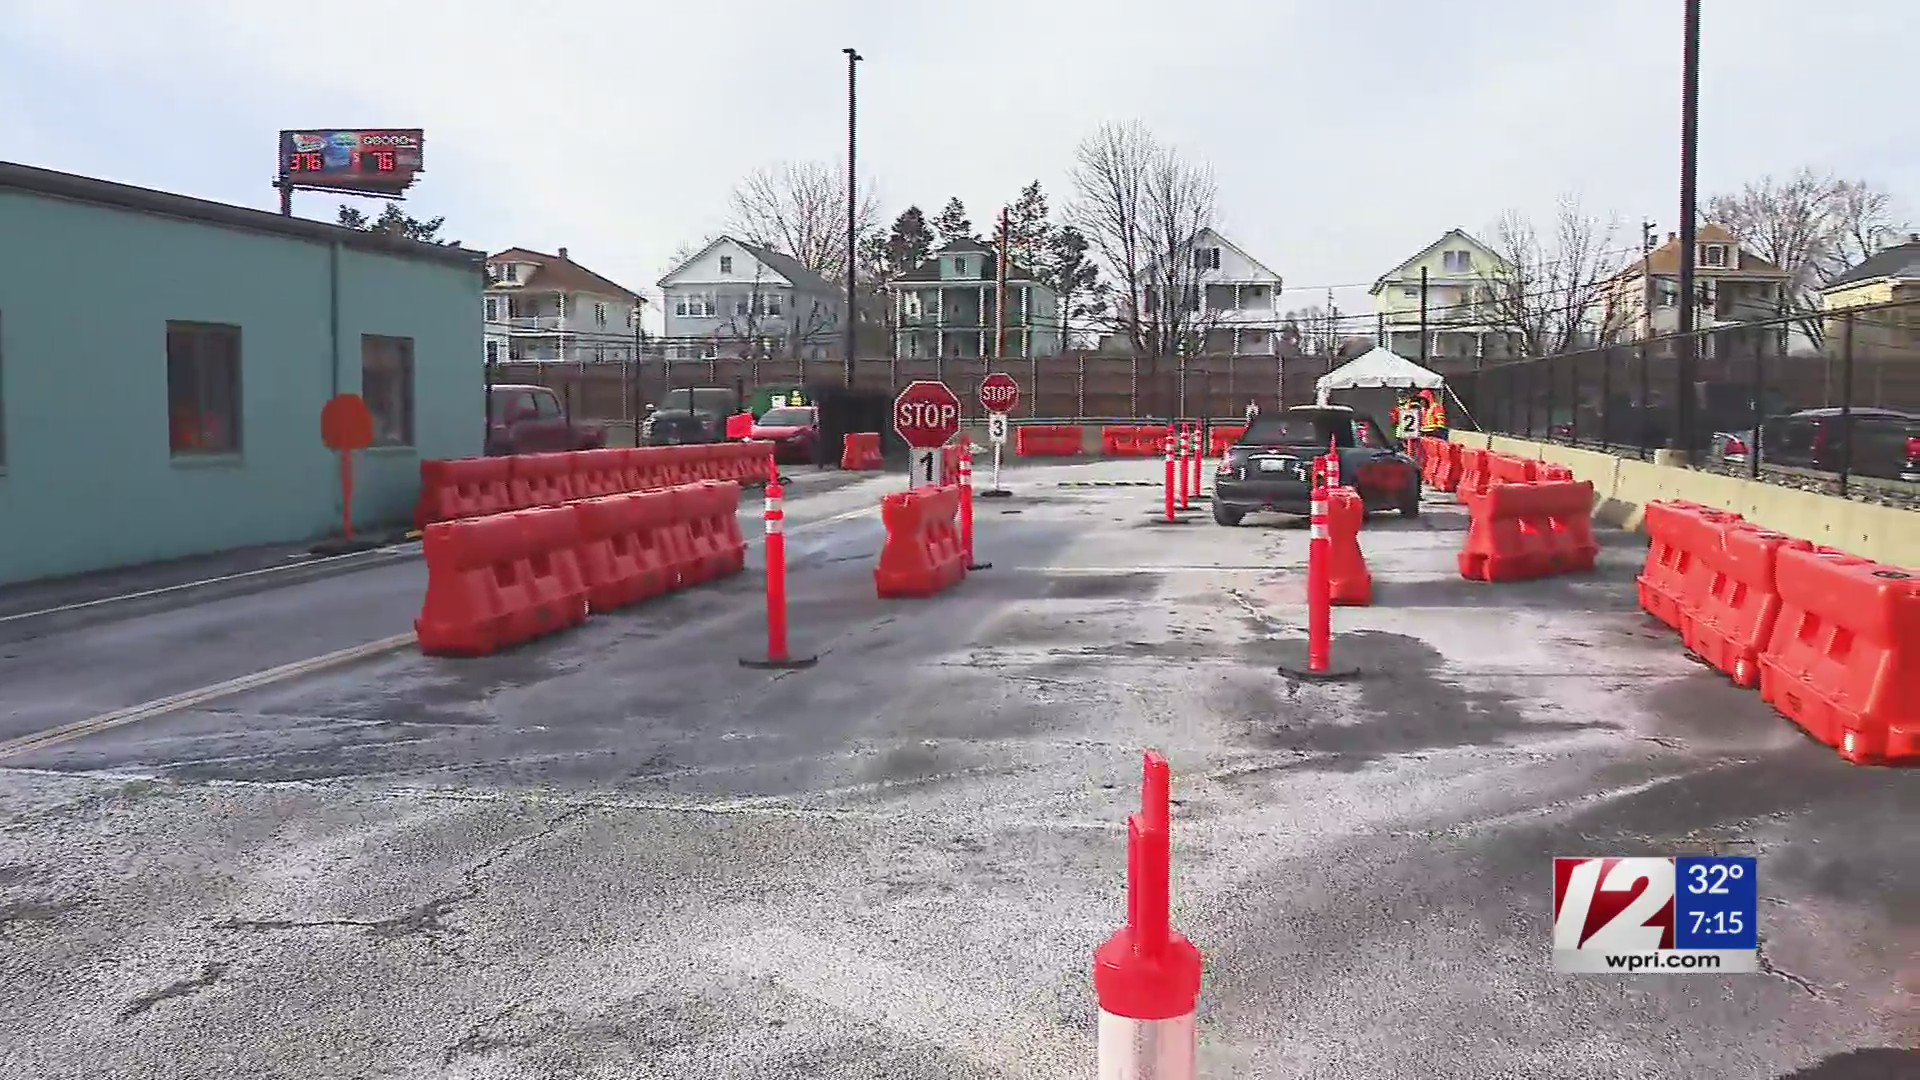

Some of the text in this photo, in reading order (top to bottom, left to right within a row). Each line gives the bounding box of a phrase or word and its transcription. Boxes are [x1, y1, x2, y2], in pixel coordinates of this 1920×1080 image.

[290, 152, 322, 171] 376
[372, 151, 393, 171] 76
[983, 386, 1016, 402] STOP
[900, 402, 956, 430] STOP
[1403, 414, 1415, 432] 2
[993, 419, 1004, 437] 3
[919, 451, 934, 482] 1
